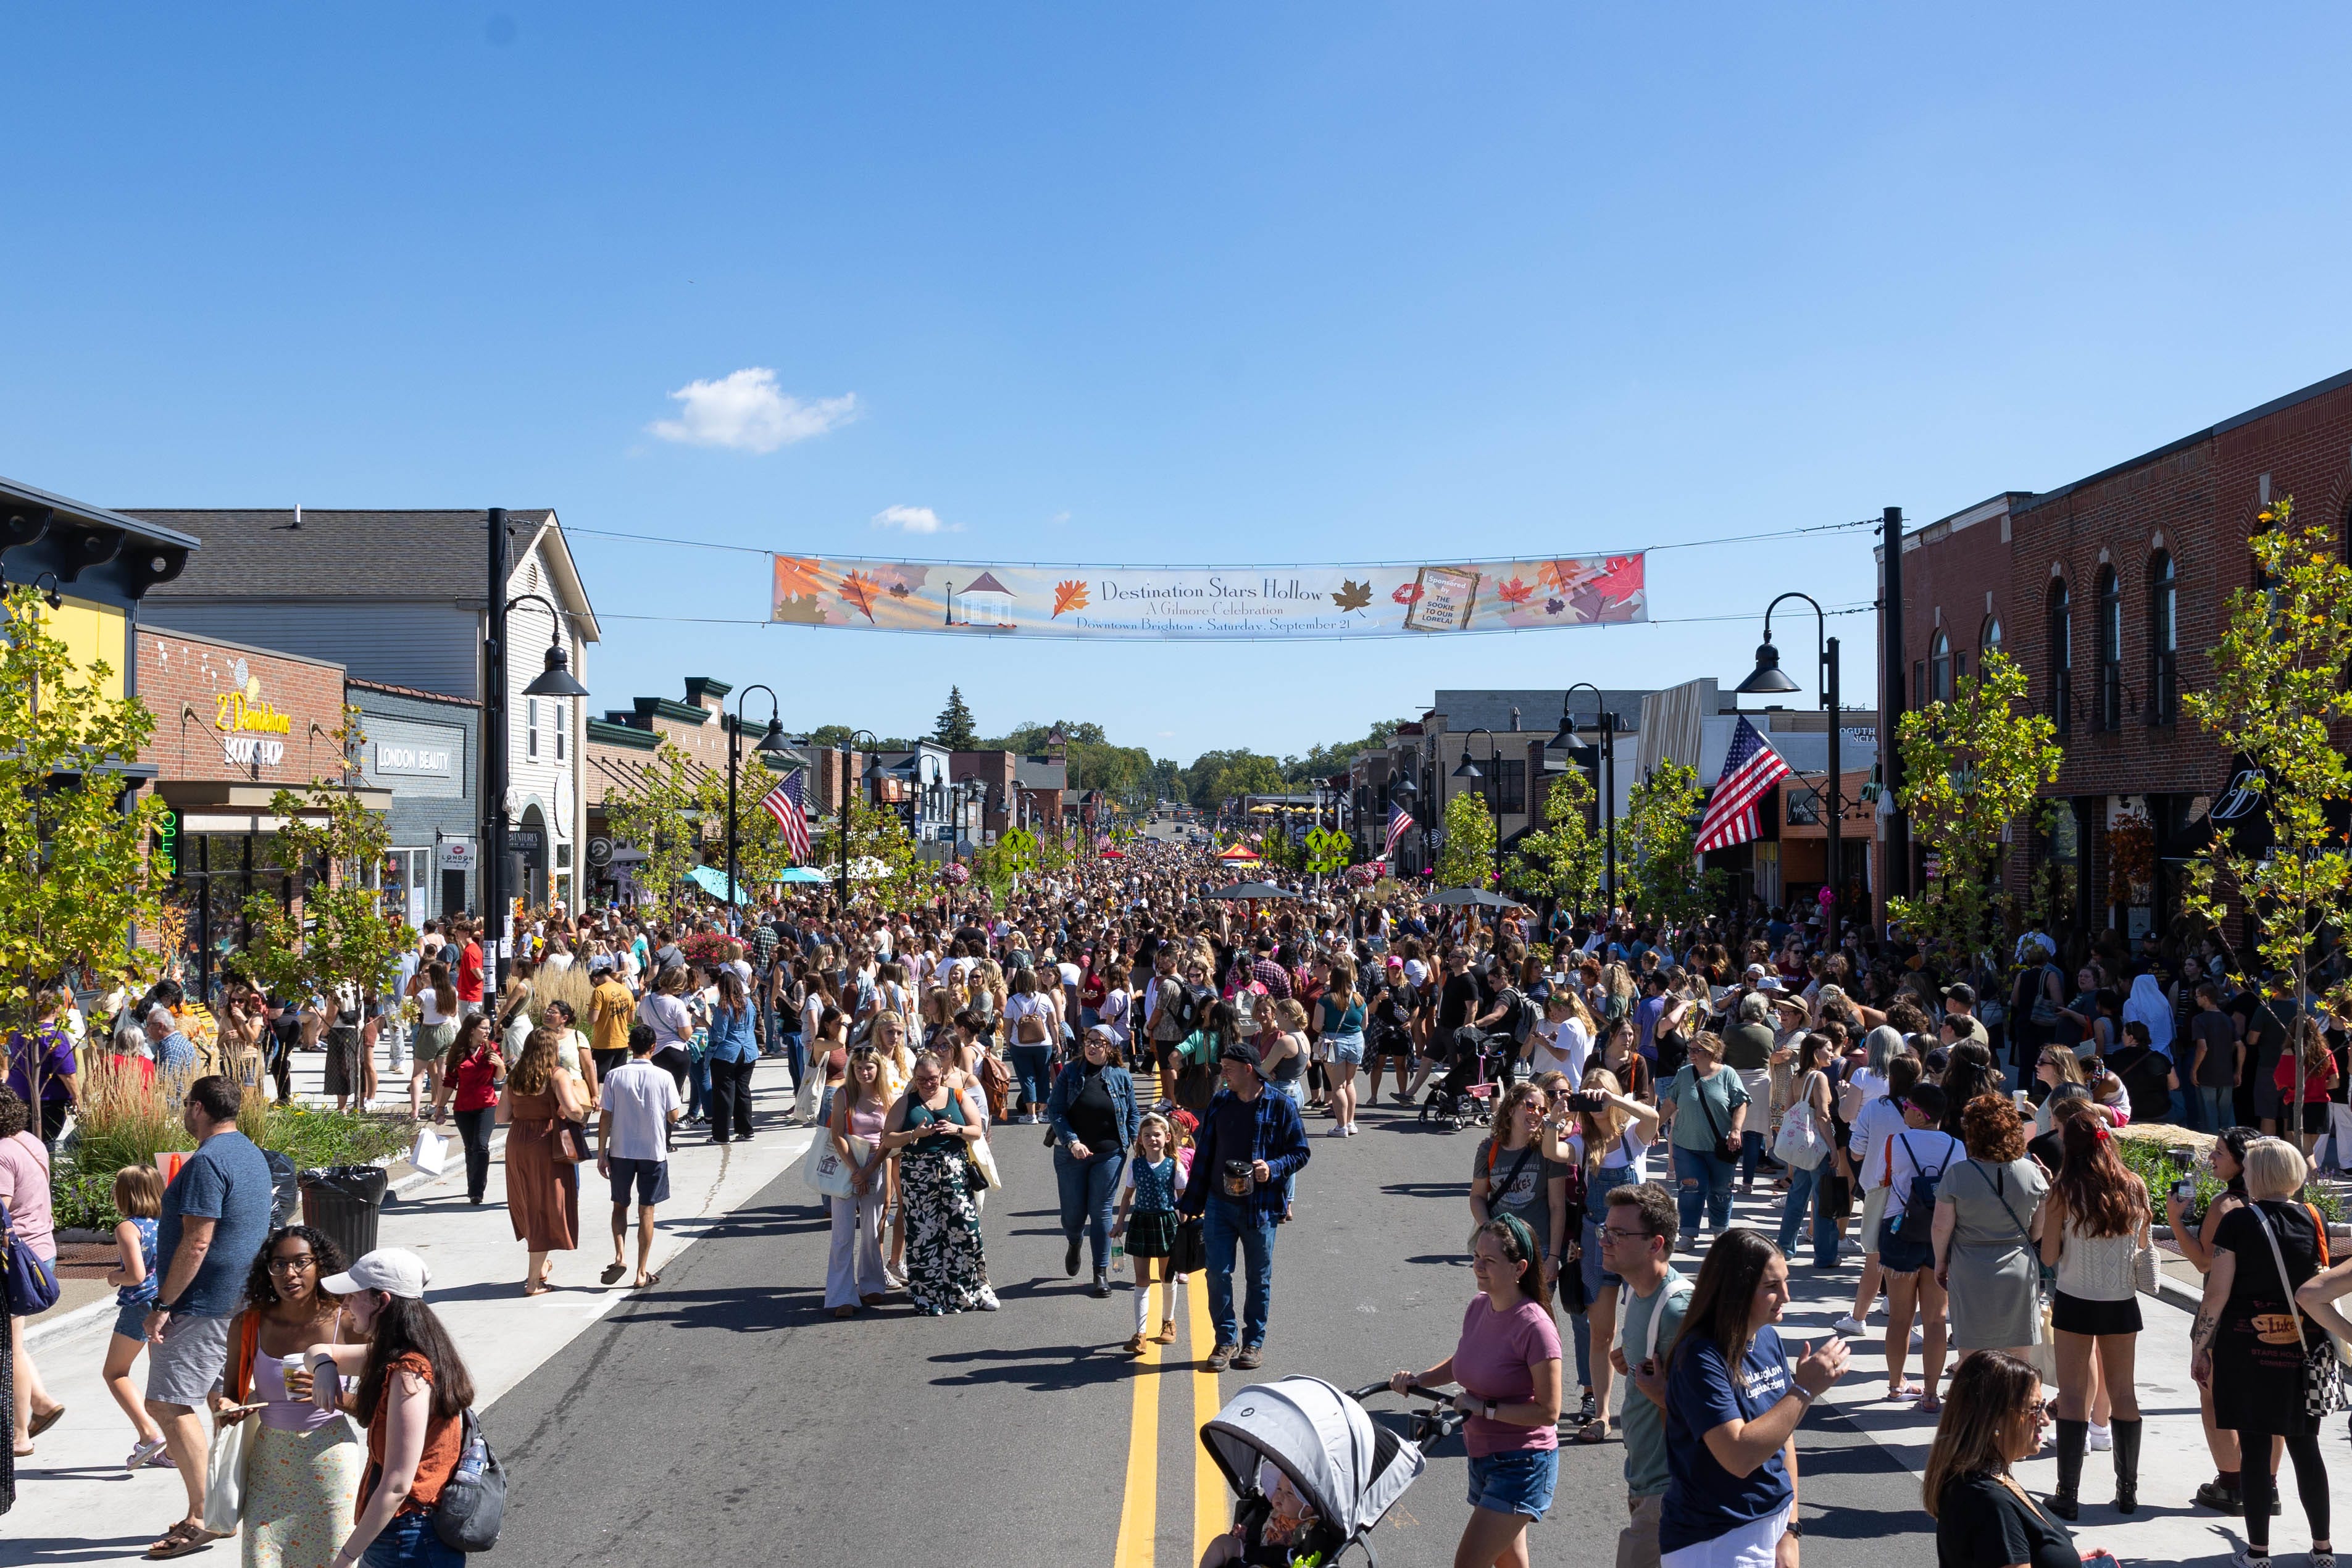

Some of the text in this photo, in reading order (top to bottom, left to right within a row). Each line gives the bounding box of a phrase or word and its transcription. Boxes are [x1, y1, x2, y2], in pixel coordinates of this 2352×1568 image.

[1102, 577, 1323, 601] Destination Stars Hollow
[1428, 576, 1466, 589] Sponsored
[1146, 601, 1283, 615] A Gilmore Celebration
[1427, 601, 1455, 611] SOOKIE
[1077, 617, 1136, 629] Downtown
[1142, 618, 1193, 633] Brighton
[1270, 617, 1337, 632] September
[1339, 619, 1350, 629] 21
[1422, 615, 1453, 624] LORELAI
[216, 691, 291, 735] 2 Dandelions
[223, 736, 284, 766] BOOKSHOP
[379, 748, 449, 770] LONDON BEAUTY
